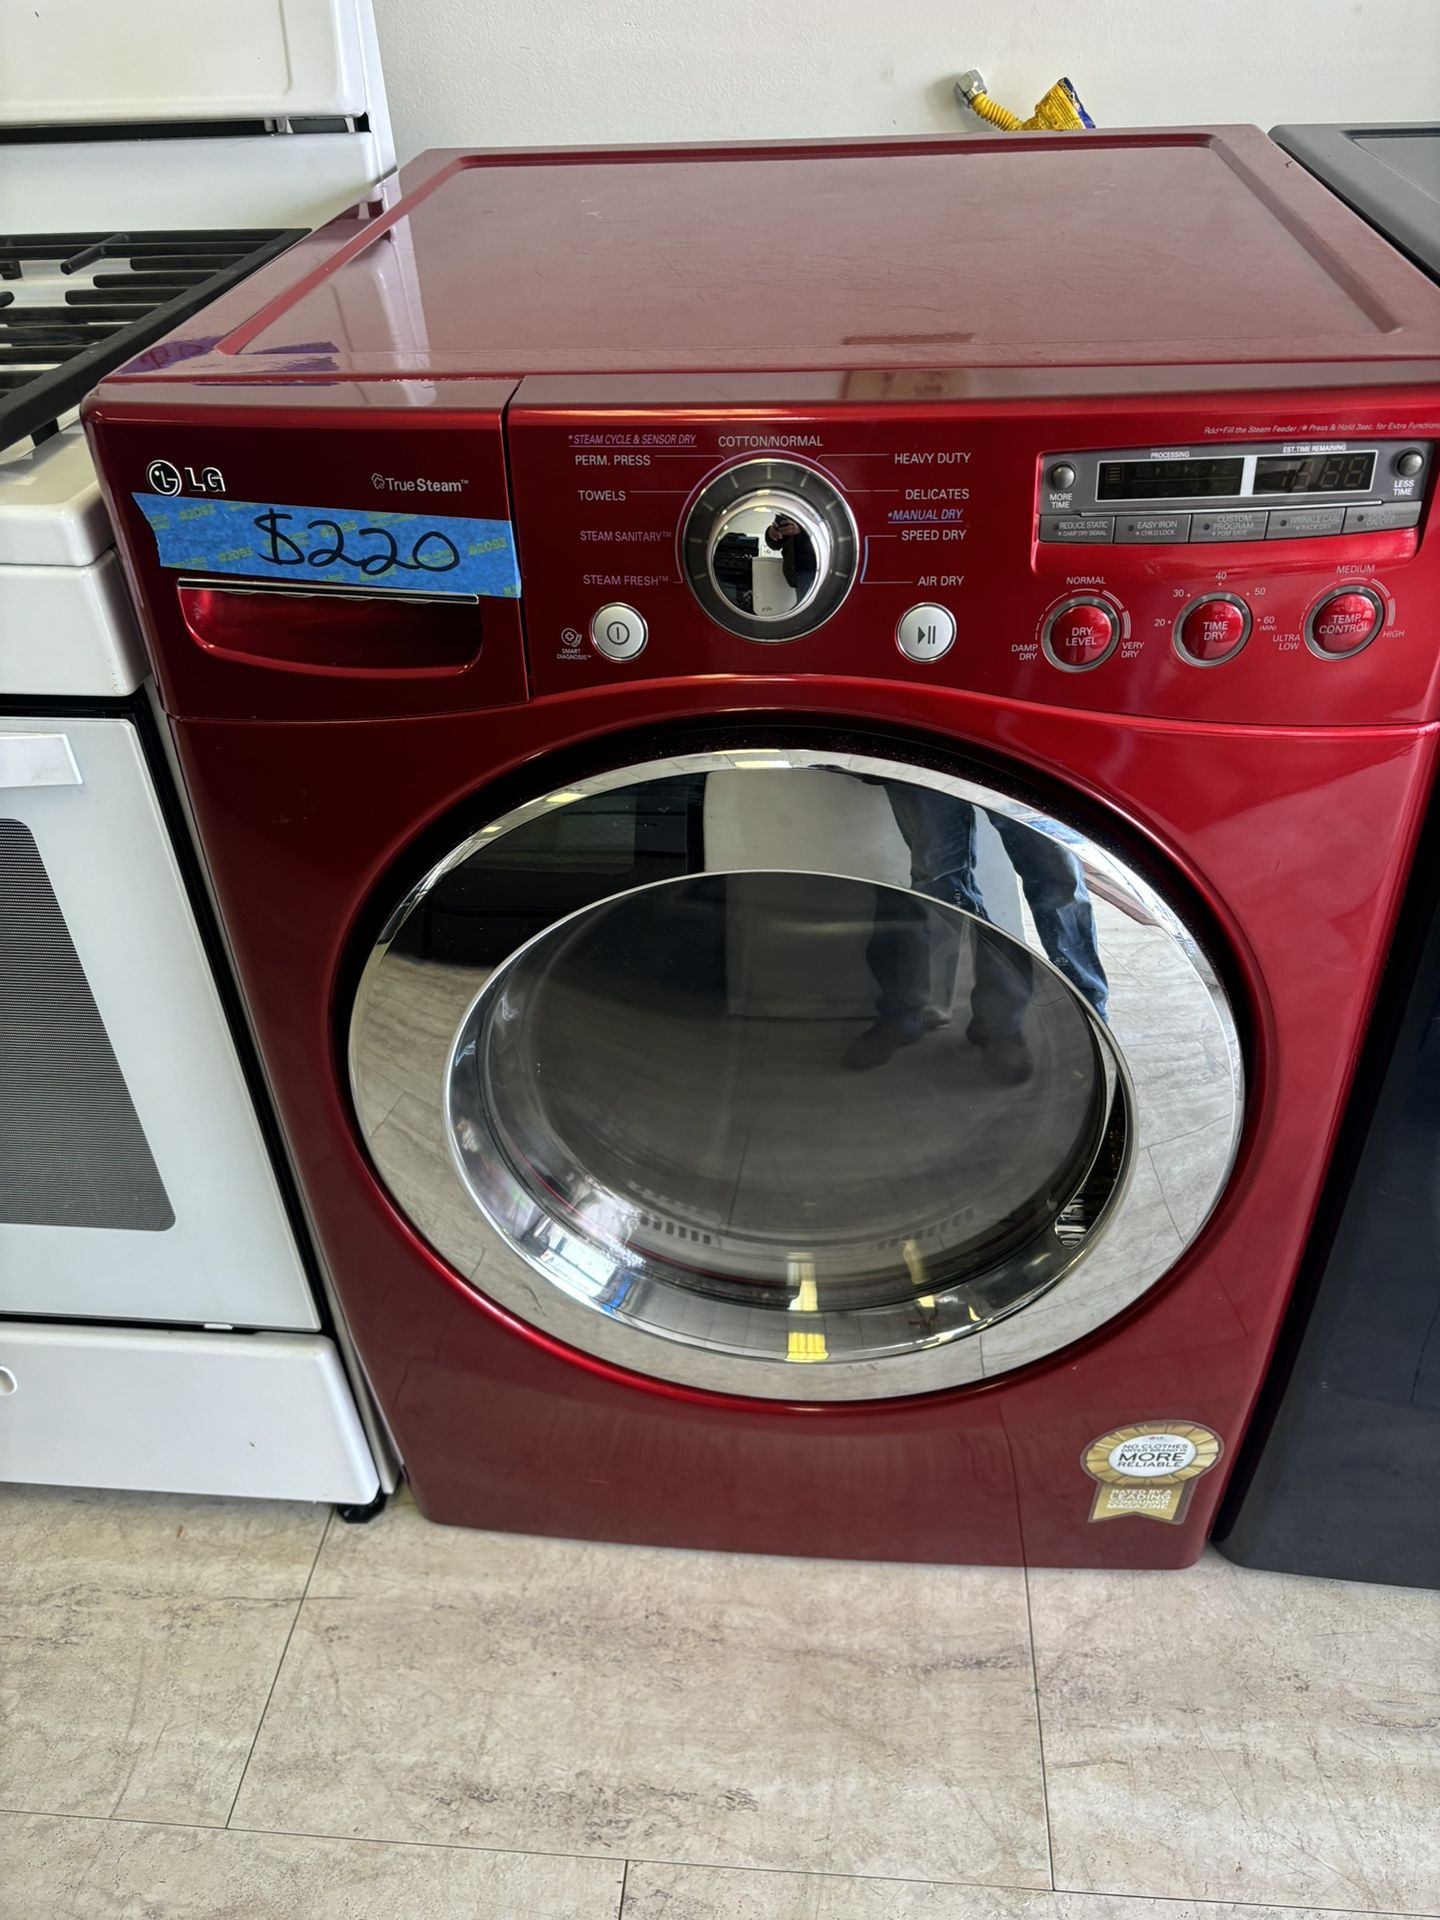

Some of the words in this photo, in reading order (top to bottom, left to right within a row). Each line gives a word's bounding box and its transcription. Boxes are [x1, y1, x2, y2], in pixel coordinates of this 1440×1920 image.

[1248, 425, 1272, 434] Steam
[1272, 424, 1297, 433] Feeder
[1308, 424, 1328, 432] Press
[1337, 423, 1356, 431] Hold
[1387, 422, 1407, 430] Extra
[604, 434, 632, 445] CYCLE
[633, 434, 640, 444] &
[641, 434, 677, 445] SENSOR
[678, 434, 697, 444] DRY
[718, 435, 824, 447] COTTON/NORMAL
[1312, 443, 1347, 452] REMAINING
[894, 453, 935, 464] HEAVY
[937, 452, 971, 464] DUTY
[1150, 450, 1190, 459] PROCESSING
[575, 454, 612, 466] PERM.
[613, 454, 651, 466] PRESS
[183, 466, 226, 492] LG
[1394, 479, 1415, 488] LESS
[578, 490, 626, 501] TOWELS
[905, 488, 970, 500] DELICATES
[1393, 488, 1413, 496] TIME
[1049, 493, 1073, 501] MORE
[1051, 500, 1071, 509] TIME
[940, 509, 963, 520] DRY
[1216, 514, 1252, 523] CUSTOM
[1059, 521, 1086, 530] REDUCE
[1087, 521, 1108, 529] STATIC
[1137, 521, 1157, 529] EASY
[1158, 520, 1178, 529] IRON
[1213, 522, 1254, 531] PROGRAM
[580, 530, 613, 541] STEAM
[901, 529, 940, 541] SPEED
[942, 529, 967, 541] DRY
[254, 507, 460, 576] $220
[1336, 564, 1376, 574] MEDIUM
[583, 574, 622, 585] STEAM
[1215, 571, 1227, 580] 40
[917, 576, 938, 587] AIR
[940, 575, 965, 587] DRY
[1066, 576, 1106, 585] NORMAL
[1173, 589, 1185, 598] 30
[1254, 587, 1266, 596] 50
[1154, 618, 1166, 627] 20
[1263, 616, 1275, 625] 60
[1332, 613, 1362, 624] TEMP.
[1203, 621, 1229, 631] TIME
[1259, 624, 1277, 632] (MIN)
[1318, 624, 1369, 635] CONTROL
[1071, 627, 1094, 637] DRY
[1203, 631, 1226, 640] DRY
[1382, 630, 1405, 639] HIGH
[1066, 637, 1097, 646] LEVEL
[1272, 634, 1300, 642] ULTRA
[1011, 644, 1038, 653] DAMP
[1122, 642, 1144, 650] VERY
[1278, 642, 1300, 651] LOW
[1019, 652, 1038, 661] DRY
[1121, 650, 1139, 658] DRY
[1119, 1452, 1186, 1462] MORE
